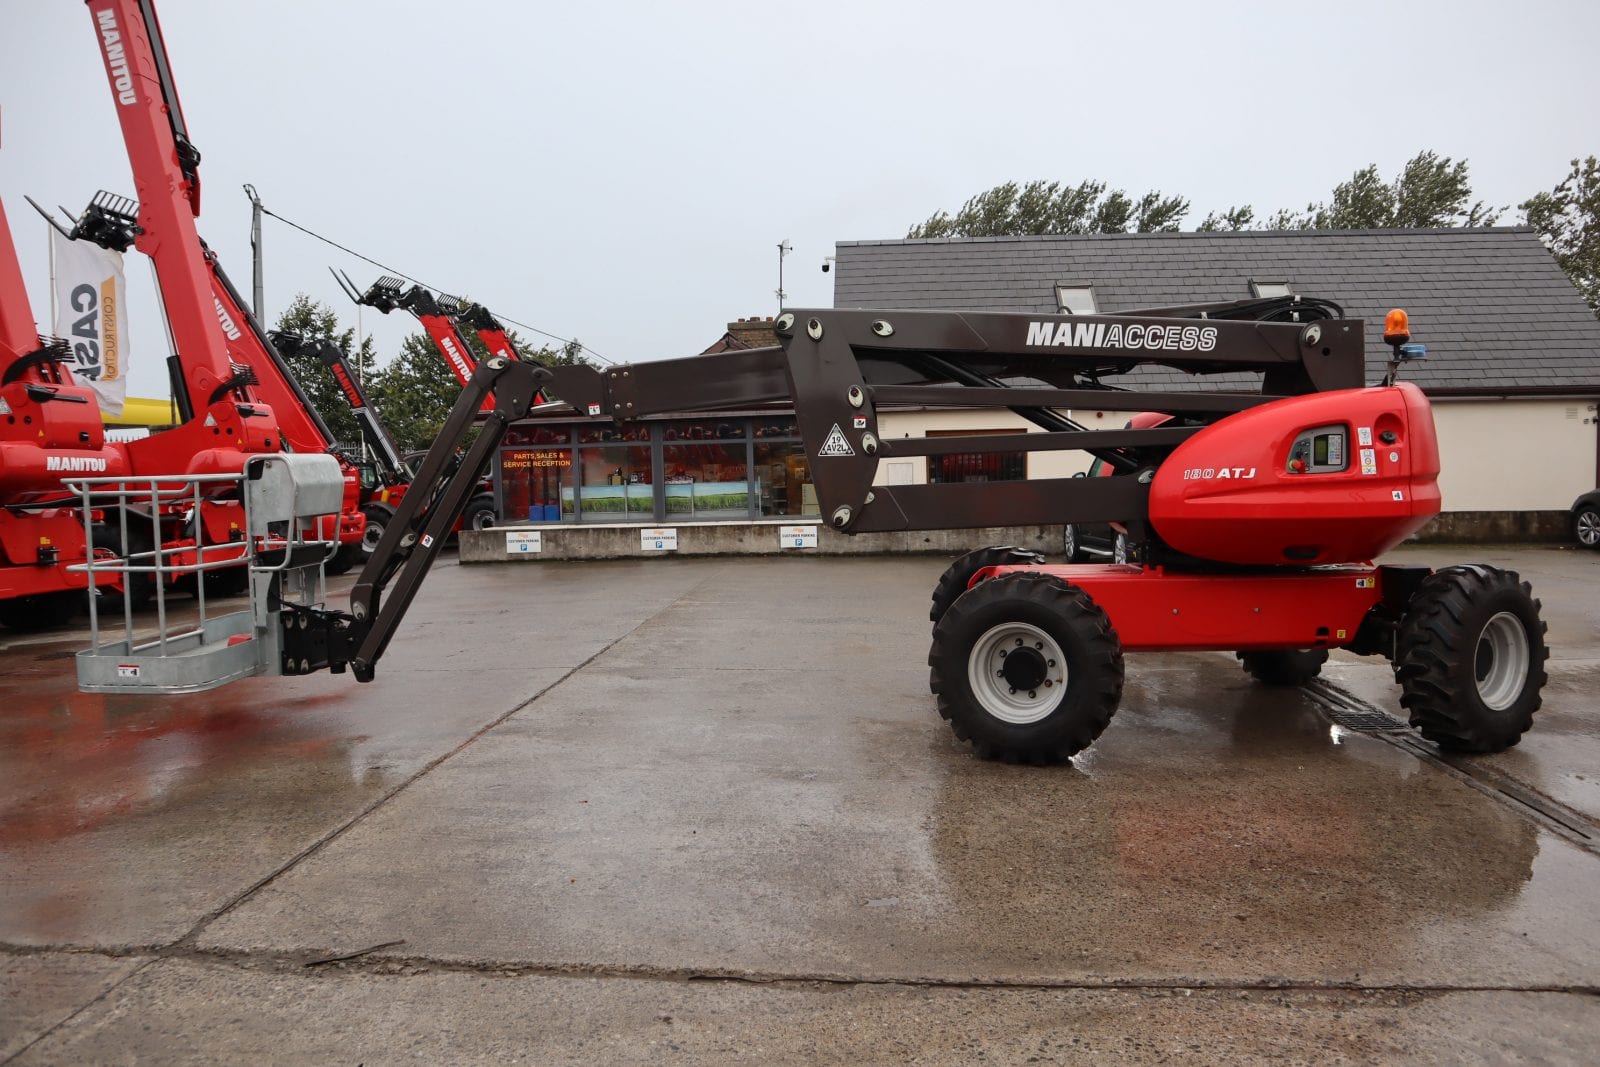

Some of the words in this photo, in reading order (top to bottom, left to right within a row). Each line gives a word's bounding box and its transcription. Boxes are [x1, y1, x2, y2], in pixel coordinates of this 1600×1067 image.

[96, 8, 137, 105] MANITOU
[1025, 321, 1218, 351] MANIACCESS
[331, 362, 363, 407] MANITOU
[831, 436, 841, 444] 19
[47, 456, 106, 471] MANITOU
[1184, 468, 1214, 479] 180
[1216, 467, 1256, 479] ATJ
